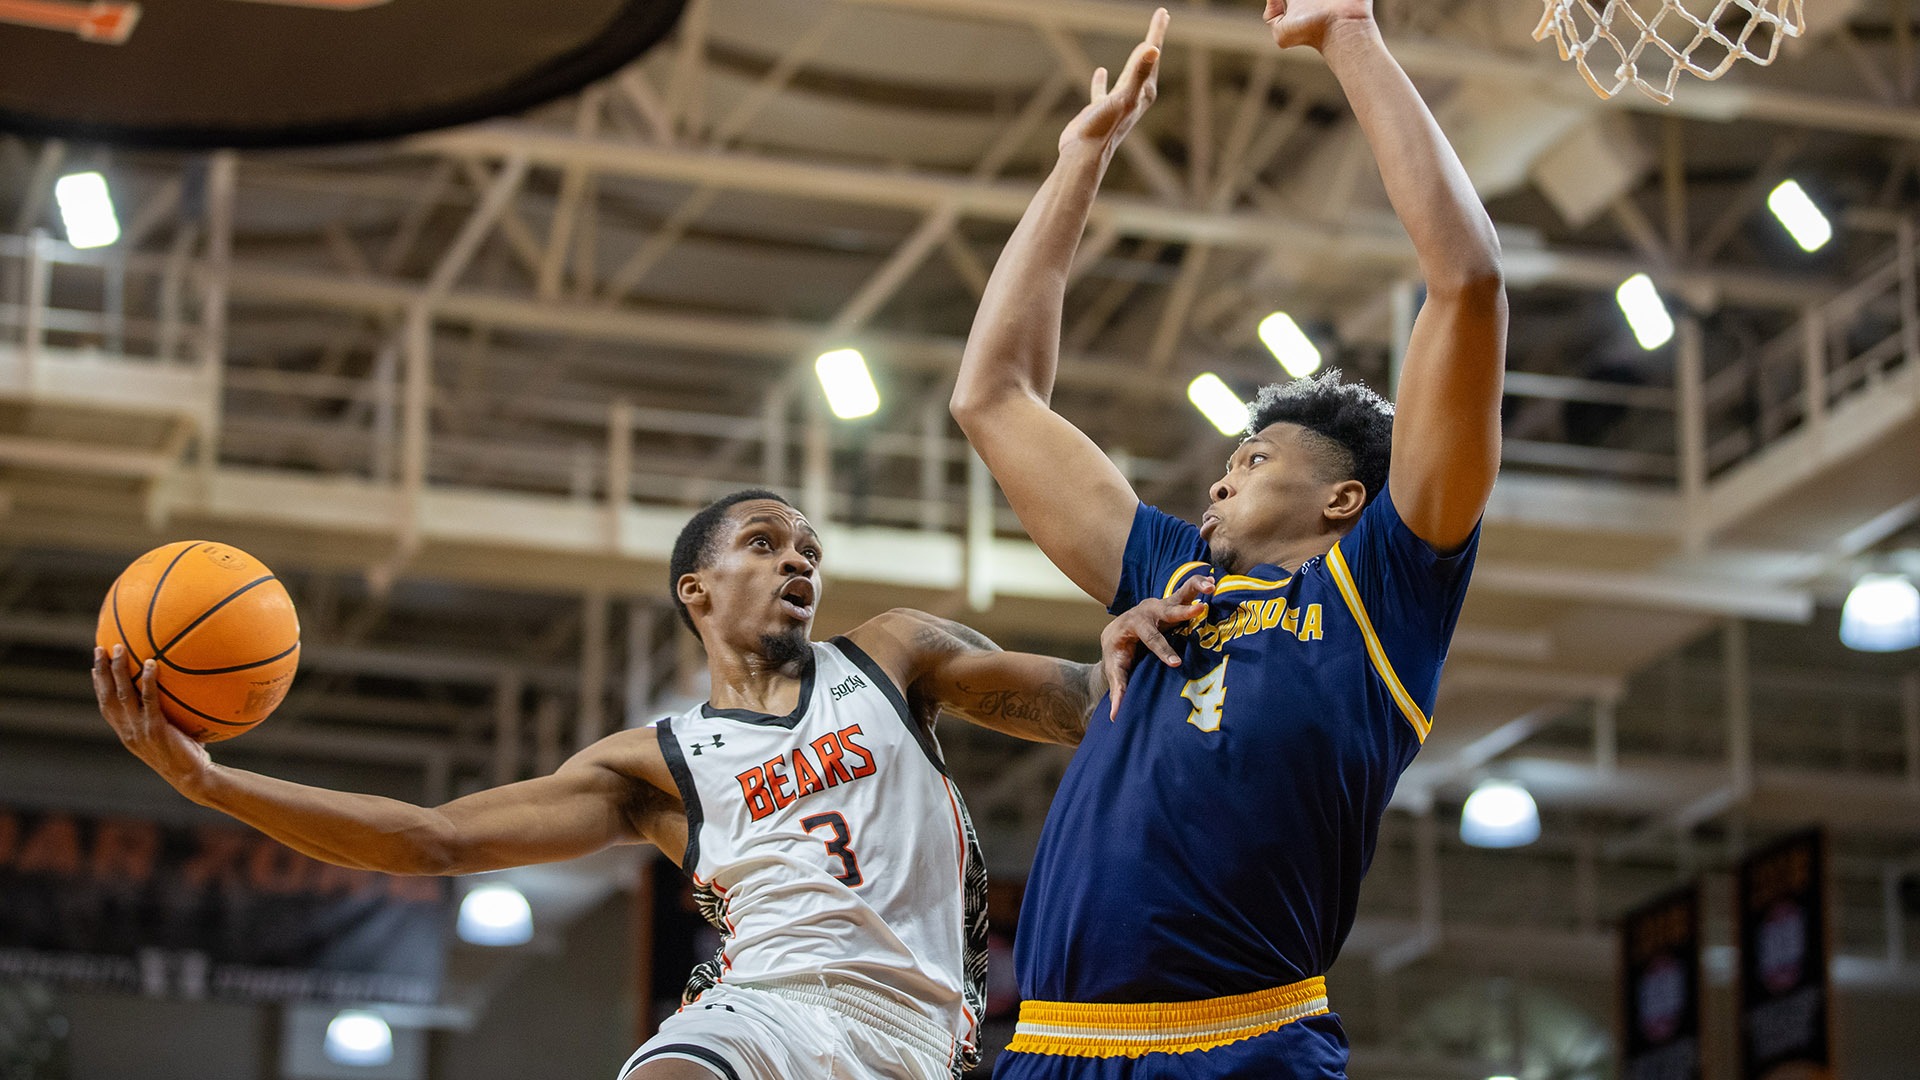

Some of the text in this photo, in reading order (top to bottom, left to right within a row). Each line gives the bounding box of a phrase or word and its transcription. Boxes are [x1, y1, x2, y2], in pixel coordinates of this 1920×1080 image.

[1180, 654, 1230, 733] 4
[735, 723, 877, 823] BEARS
[799, 811, 864, 888] 3
